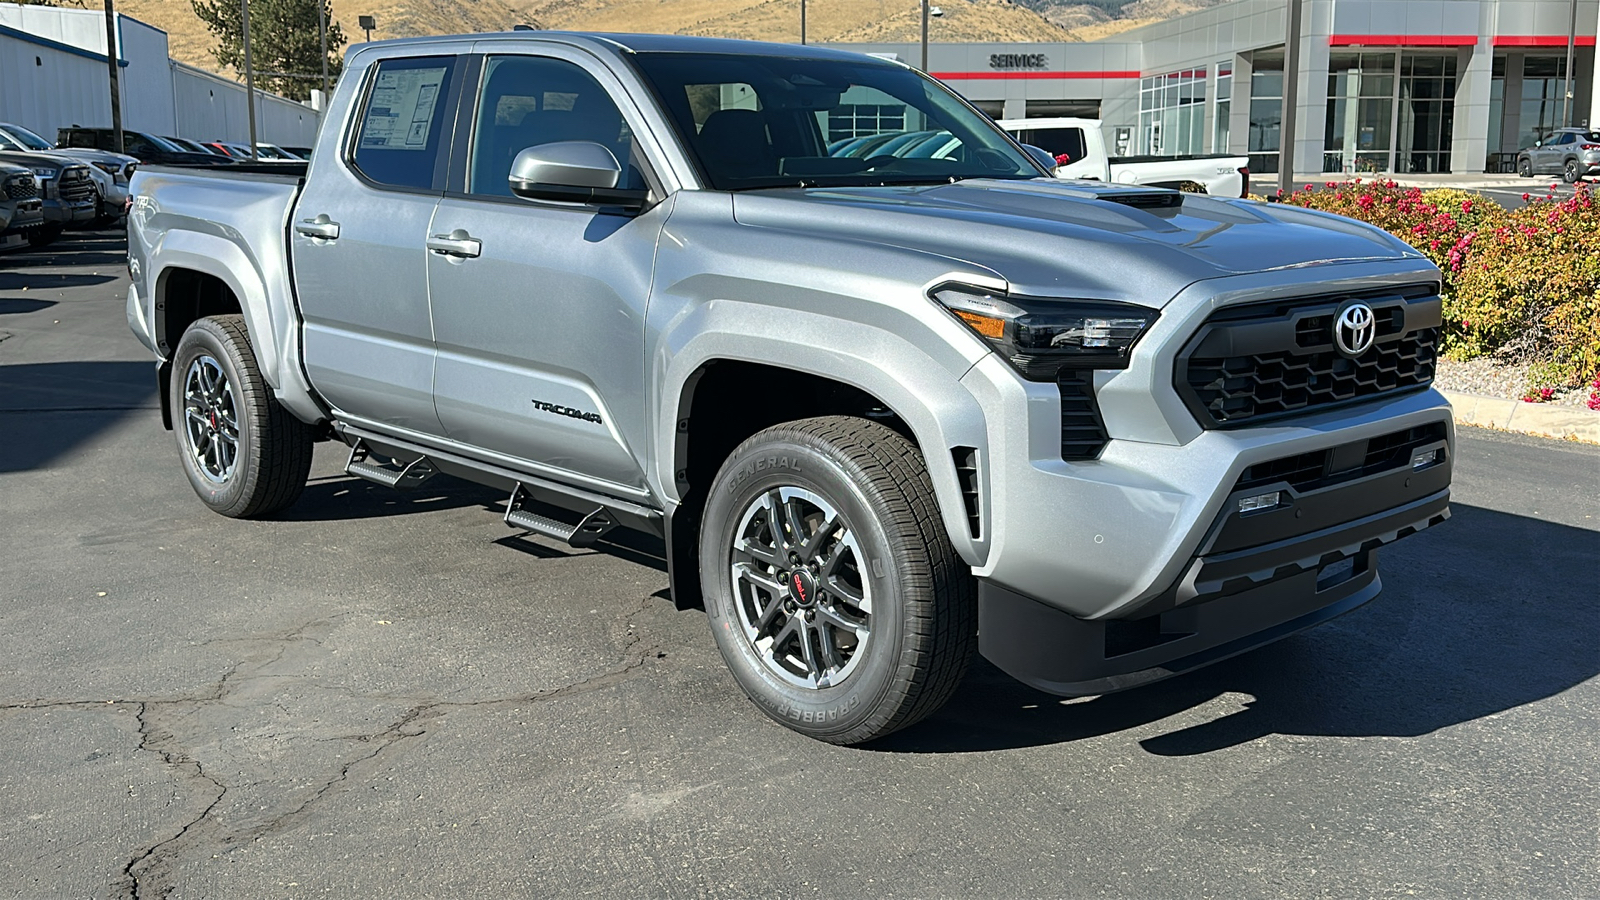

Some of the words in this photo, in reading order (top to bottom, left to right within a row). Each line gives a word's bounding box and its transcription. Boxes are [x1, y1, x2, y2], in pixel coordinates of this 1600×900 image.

[989, 53, 1046, 69] SERVICE
[531, 399, 603, 425] TACOMA
[727, 456, 803, 494] GENERAL
[793, 573, 807, 602] TRD
[777, 693, 860, 723] GRABBER
